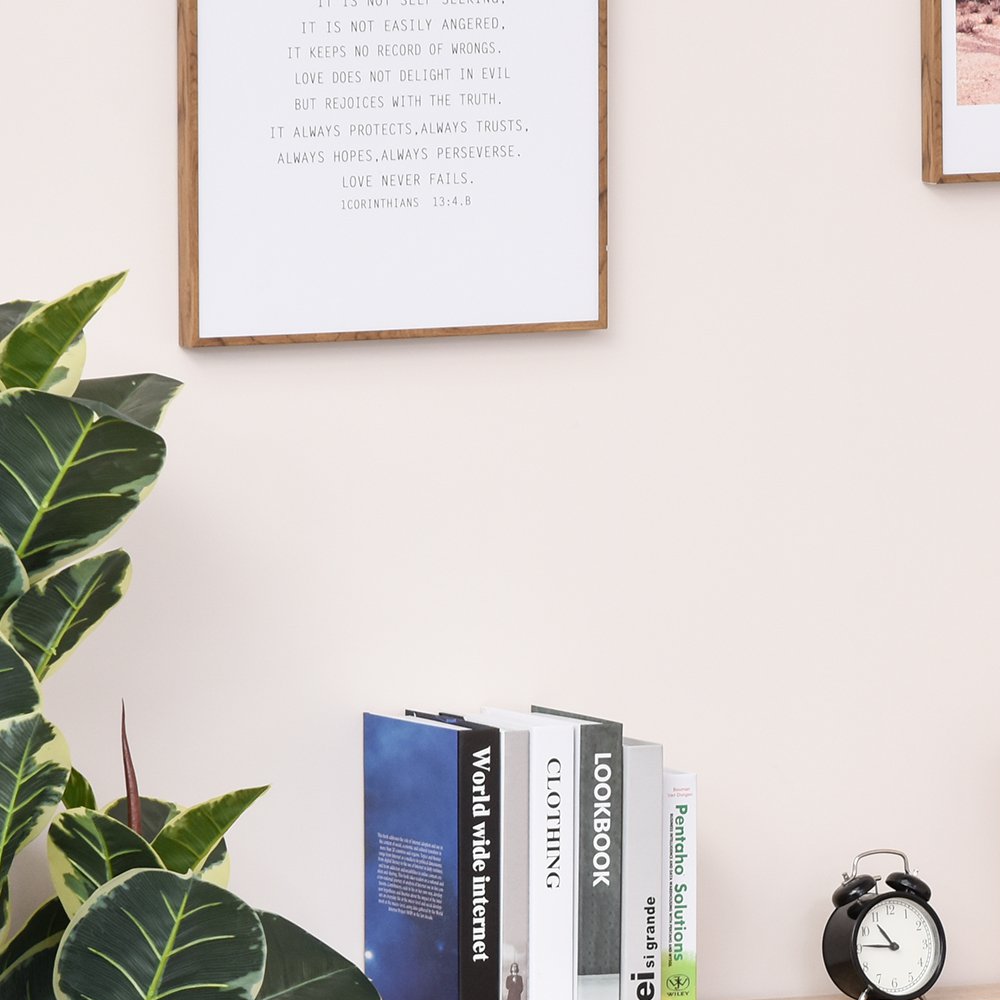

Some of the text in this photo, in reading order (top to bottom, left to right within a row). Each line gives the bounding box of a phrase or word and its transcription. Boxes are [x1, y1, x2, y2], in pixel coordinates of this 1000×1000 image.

[302, 22, 316, 34] IT
[327, 21, 341, 34] IS
[350, 20, 375, 32] NOT
[384, 19, 432, 32] EASILY
[288, 42, 501, 59] IT KEEPS NO RECORD OF WRONGS.
[295, 66, 511, 85] LOVE DOES NOT DELIGHT IN EVIL
[294, 92, 502, 110] BUT REJOICES WITH THE TRUTH.
[270, 126, 285, 139] IT
[293, 124, 341, 138] ALWAYS
[277, 150, 325, 164] ALWAYS
[437, 145, 521, 160] PERSEVERSE.
[342, 172, 474, 188] LOVE NEVER FAILS.
[341, 196, 472, 210] 1CORINTHIANS 13:4.B
[545, 757, 562, 889] CLOTHING
[592, 752, 612, 888] LOOKBOOK
[472, 745, 492, 963] World wide internet
[673, 804, 689, 962] Pentaho Solutions
[872, 912, 879, 922] 11
[886, 905, 895, 915] 12
[904, 909, 908, 919] 1
[645, 896, 658, 952] grande
[861, 926, 870, 936] 10
[916, 922, 922, 931] 2
[922, 940, 928, 950] 3
[643, 954, 656, 969] si
[863, 962, 869, 972] 8
[918, 957, 923, 967] 4
[876, 974, 883, 984] 7
[891, 978, 898, 988] 6
[908, 972, 914, 982] 5
